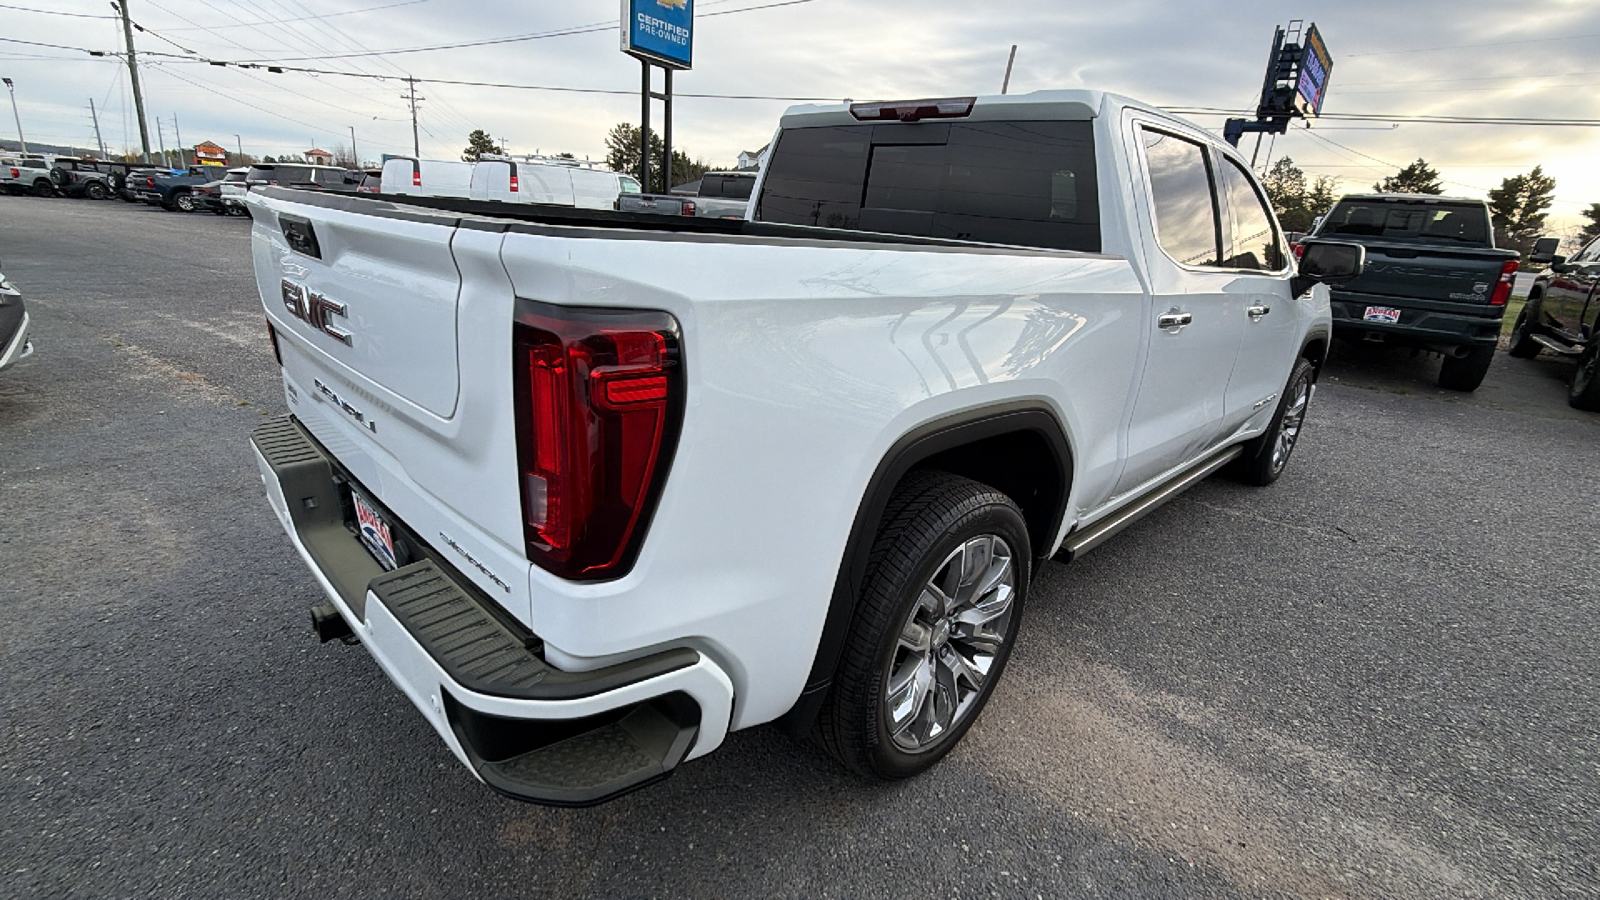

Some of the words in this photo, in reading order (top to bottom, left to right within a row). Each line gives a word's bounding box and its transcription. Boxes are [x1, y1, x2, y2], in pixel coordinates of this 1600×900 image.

[637, 12, 689, 38] CERTIFIED
[639, 22, 687, 46] PRE-OWNED
[280, 276, 353, 349] GMC
